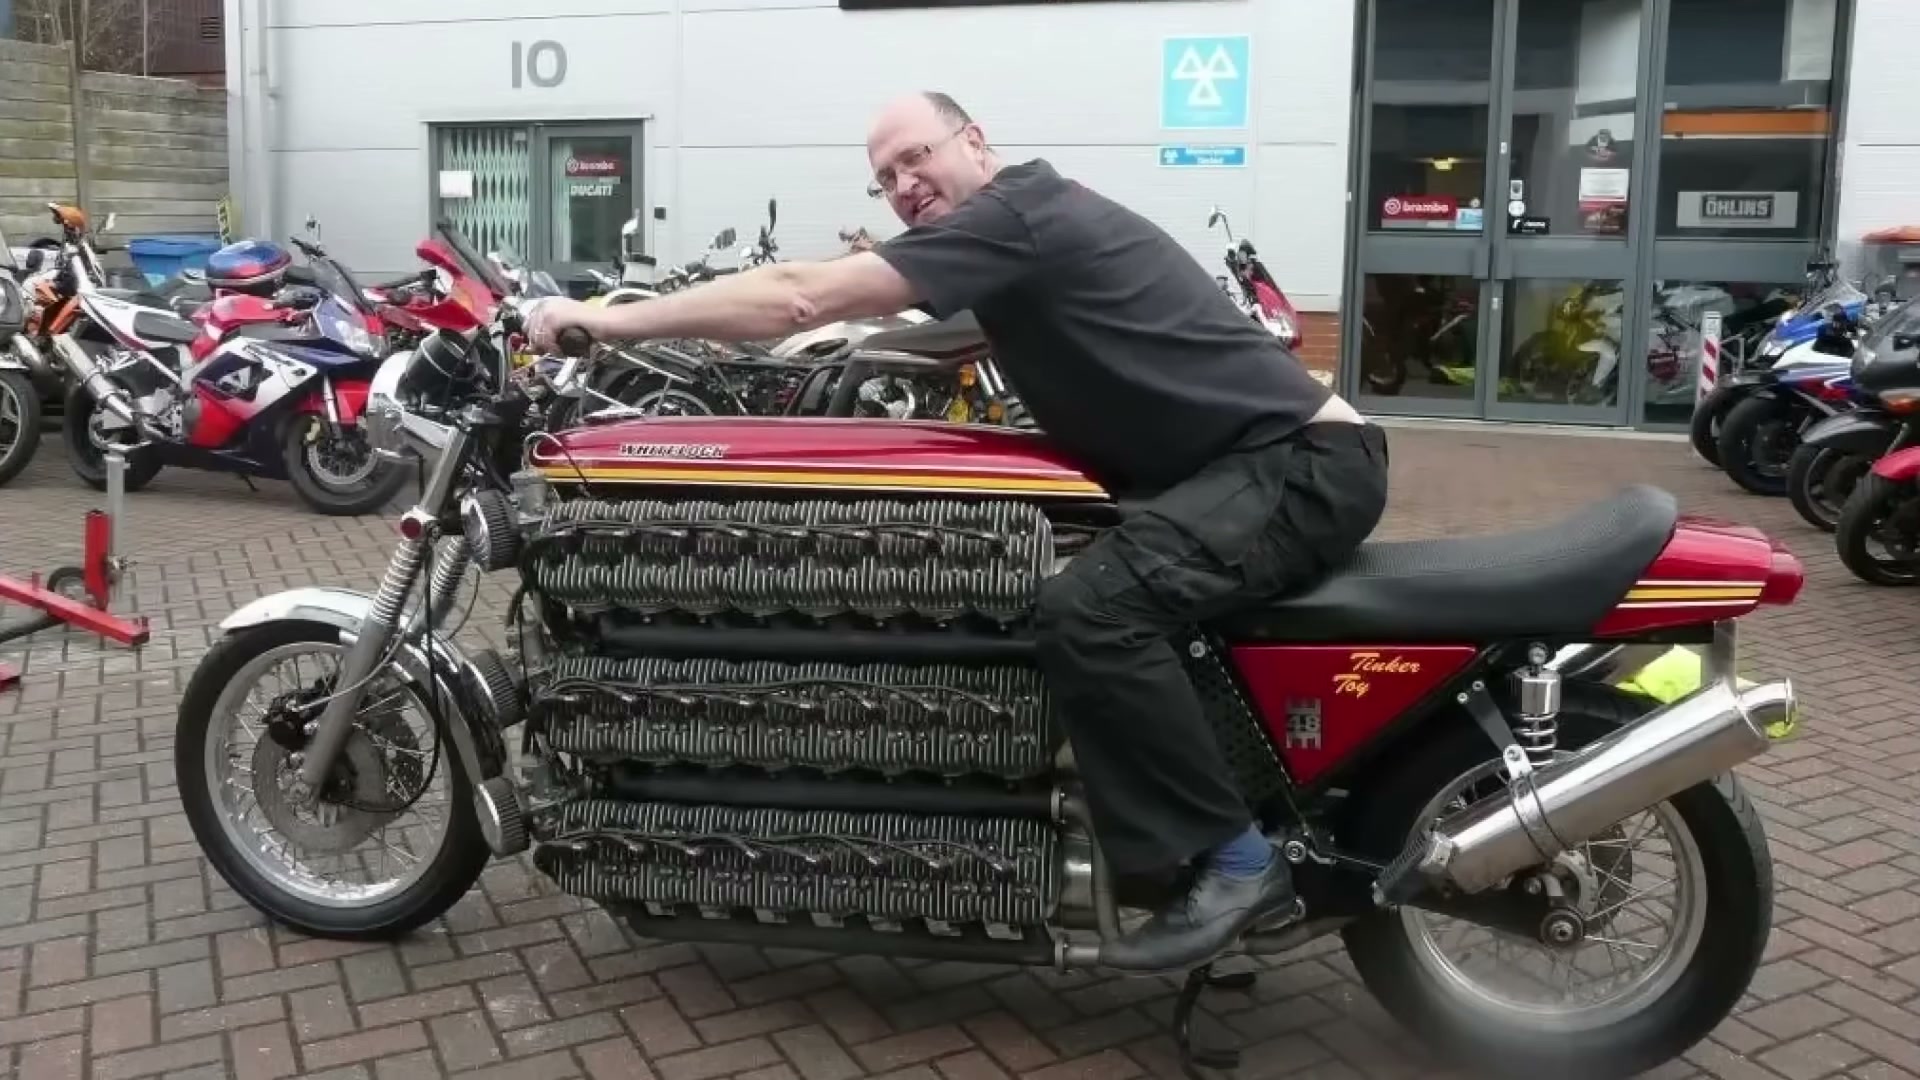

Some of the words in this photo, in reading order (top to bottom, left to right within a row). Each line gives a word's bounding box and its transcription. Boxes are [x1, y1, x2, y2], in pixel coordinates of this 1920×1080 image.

[570, 184, 613, 196] DUCATI
[1350, 652, 1421, 673] Tinker
[1332, 673, 1370, 699] Toy
